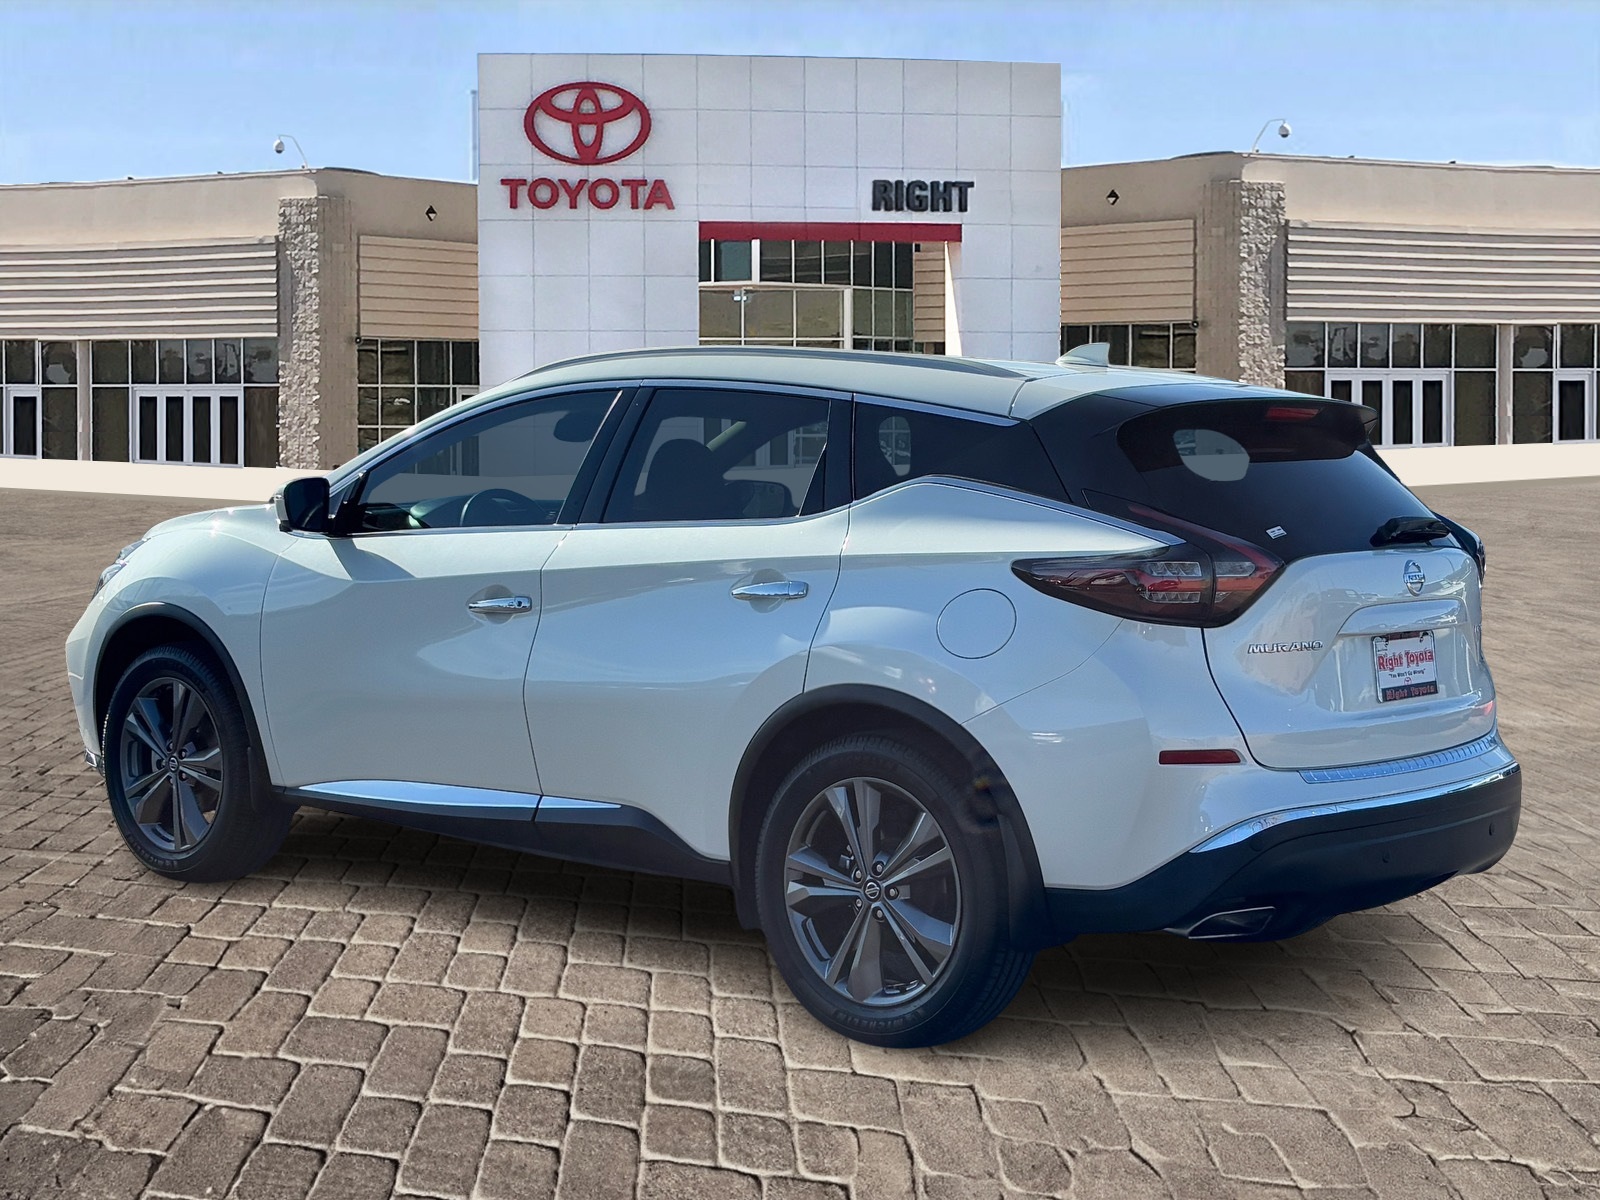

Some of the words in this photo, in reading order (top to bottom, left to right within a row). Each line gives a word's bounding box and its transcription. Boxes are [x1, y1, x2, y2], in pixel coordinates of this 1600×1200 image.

[500, 177, 675, 209] TOYOTA
[872, 179, 974, 212] RIGHT
[1247, 640, 1323, 654] MURANO
[1378, 652, 1403, 671] Right
[1405, 649, 1434, 668] Toyota
